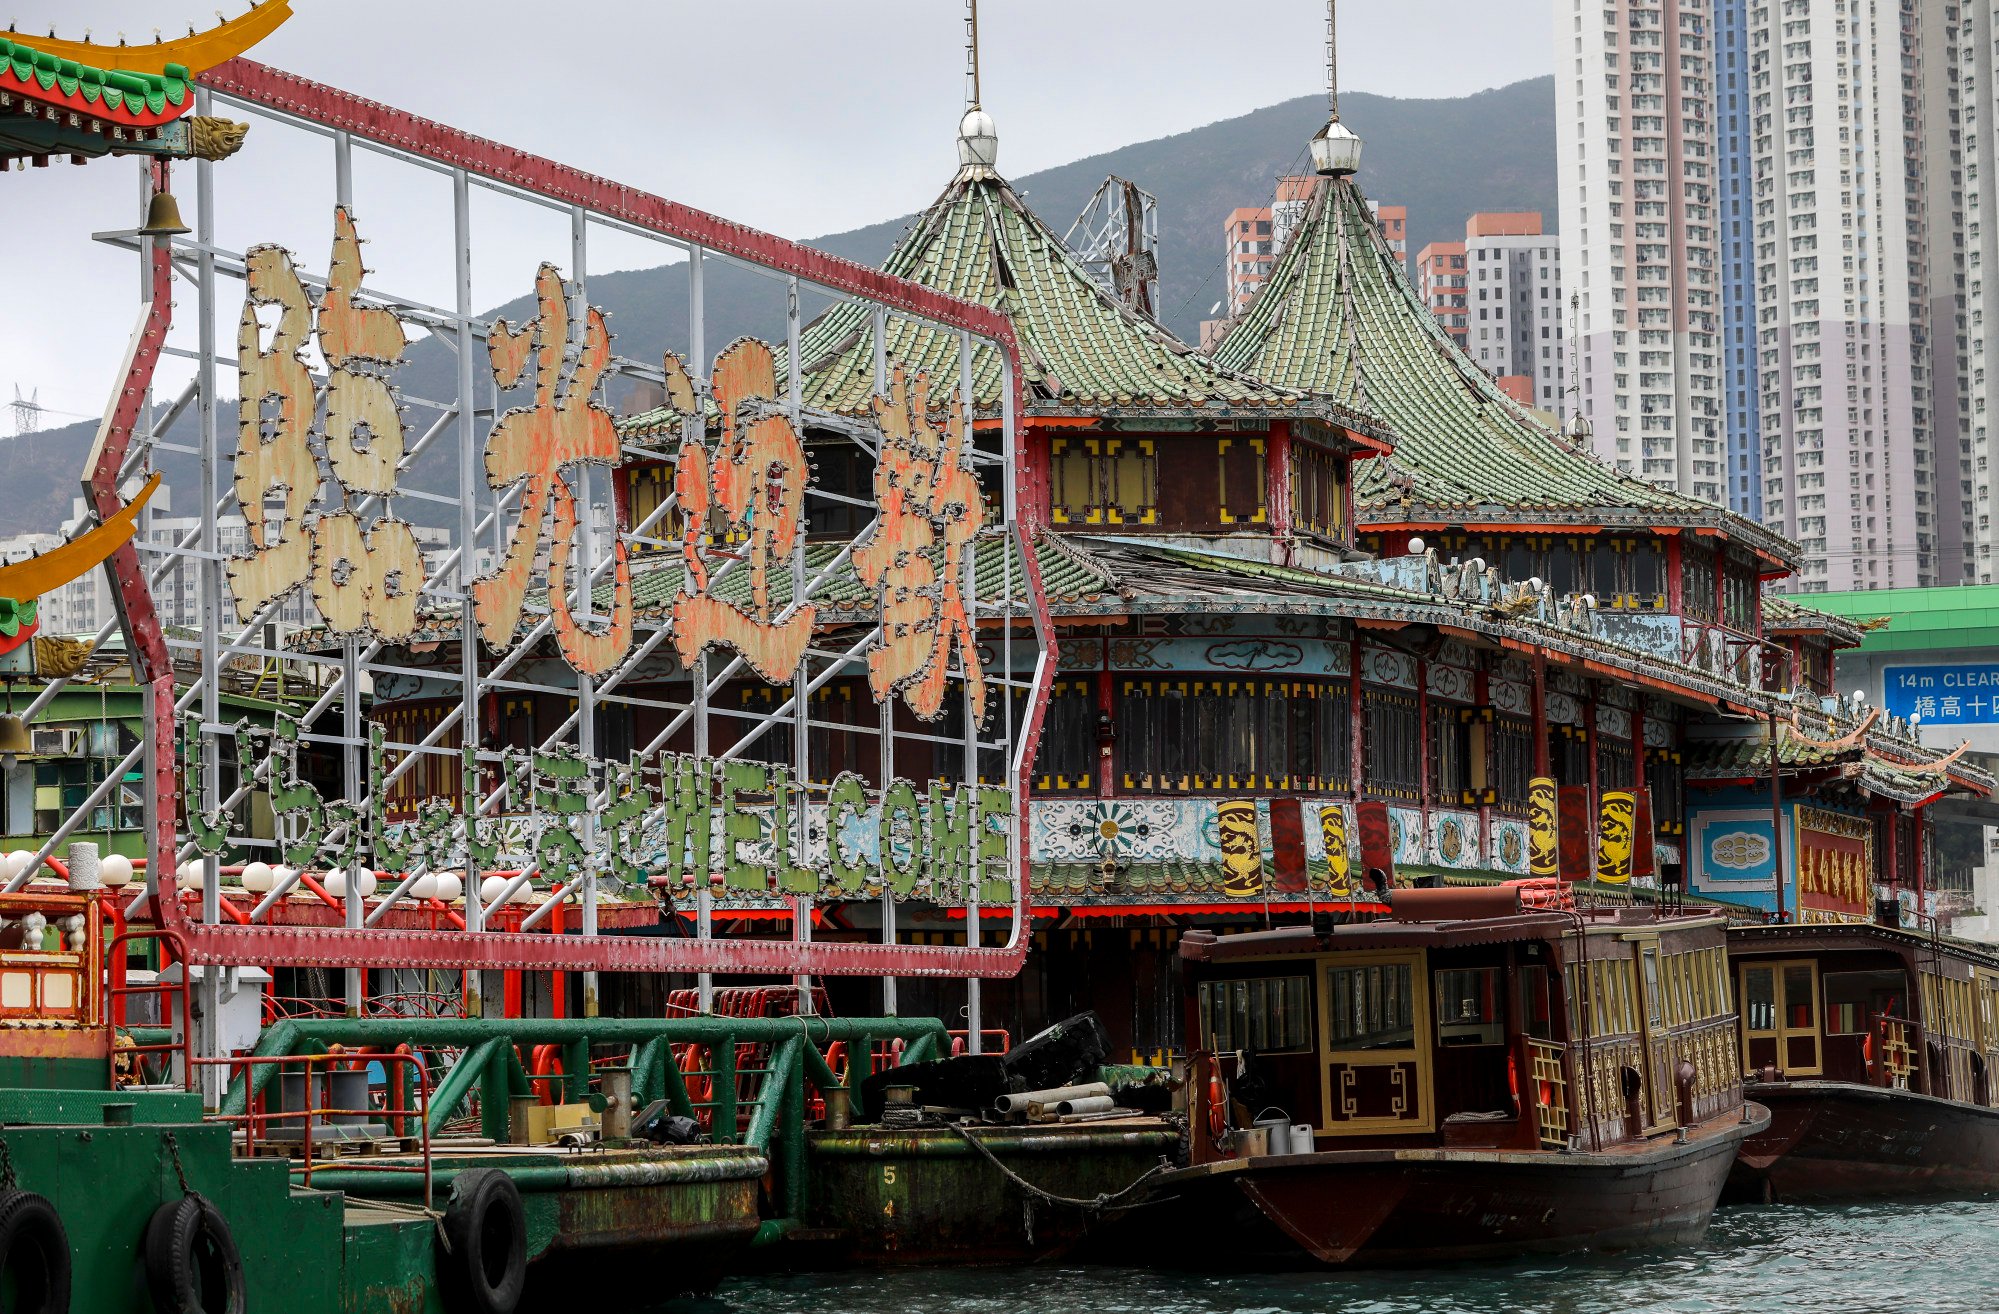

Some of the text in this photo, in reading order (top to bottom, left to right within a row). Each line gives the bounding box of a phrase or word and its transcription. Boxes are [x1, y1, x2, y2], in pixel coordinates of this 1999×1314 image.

[1943, 672, 1999, 687] CLEAR
[660, 750, 1015, 904] WELCOME
[883, 1165, 897, 1185] 5
[883, 1199, 896, 1218] 4
